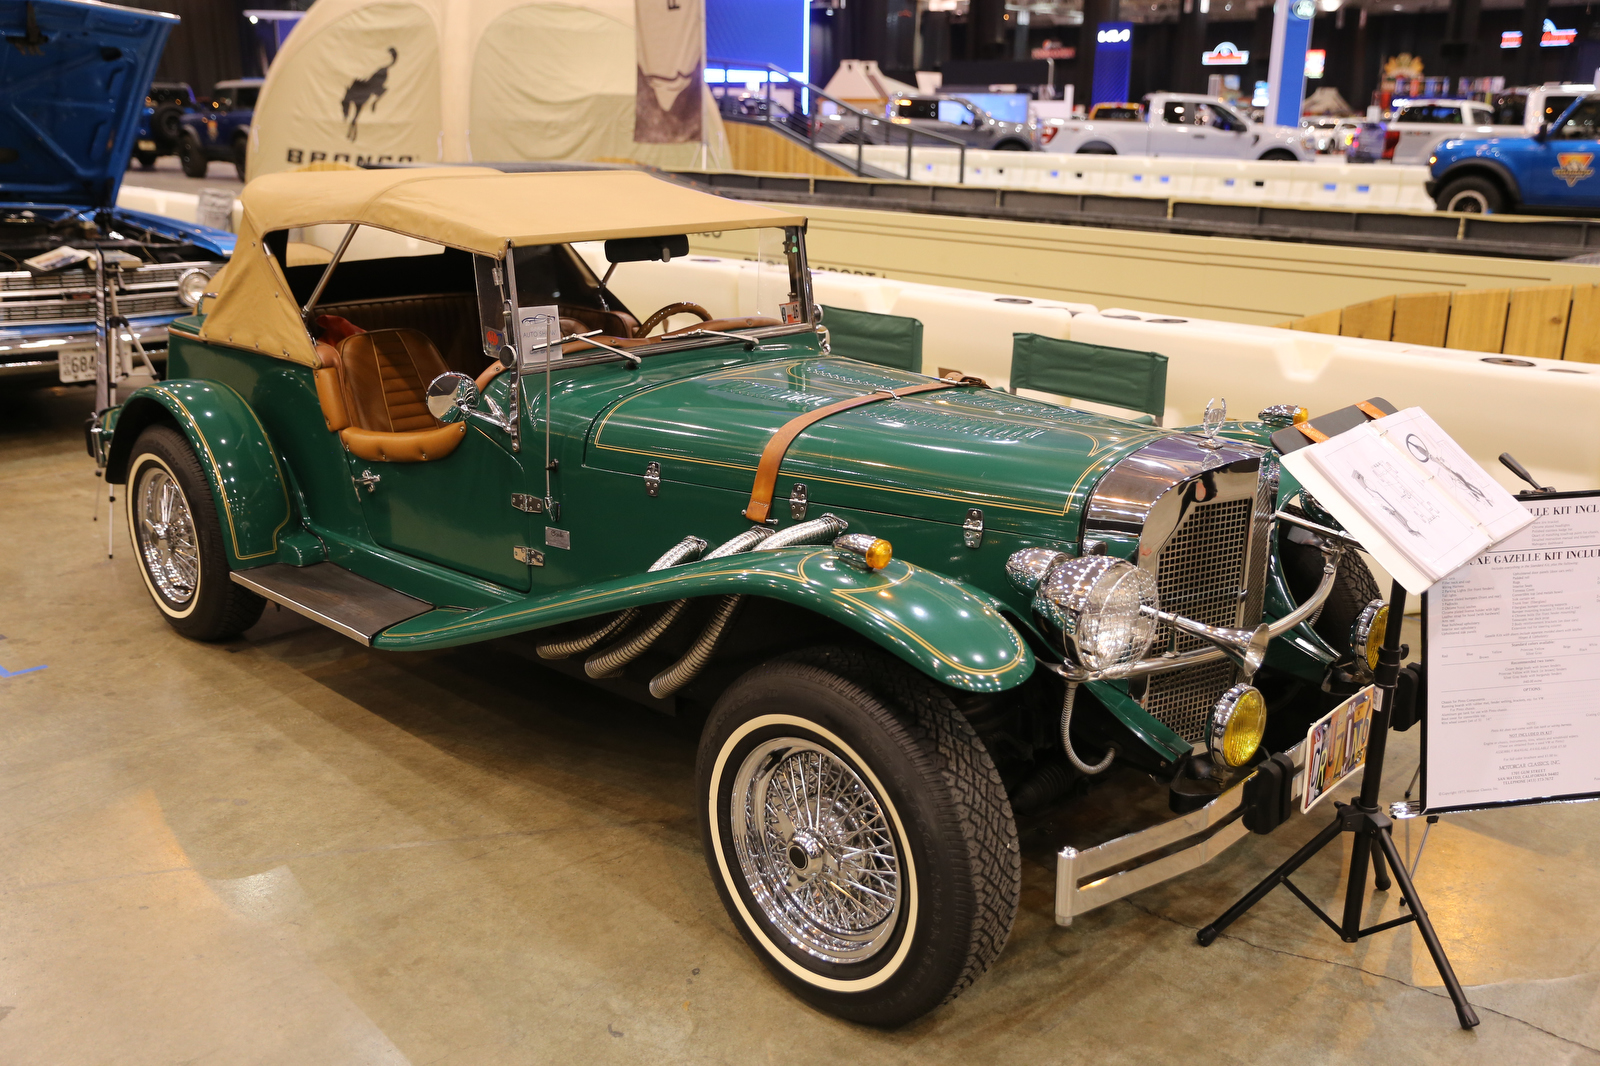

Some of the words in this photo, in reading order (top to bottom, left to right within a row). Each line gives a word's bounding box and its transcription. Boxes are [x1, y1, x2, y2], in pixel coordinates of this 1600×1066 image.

[1553, 506, 1573, 516] KIT
[1494, 552, 1541, 564] GAZELLE
[1544, 551, 1564, 561] KIT
